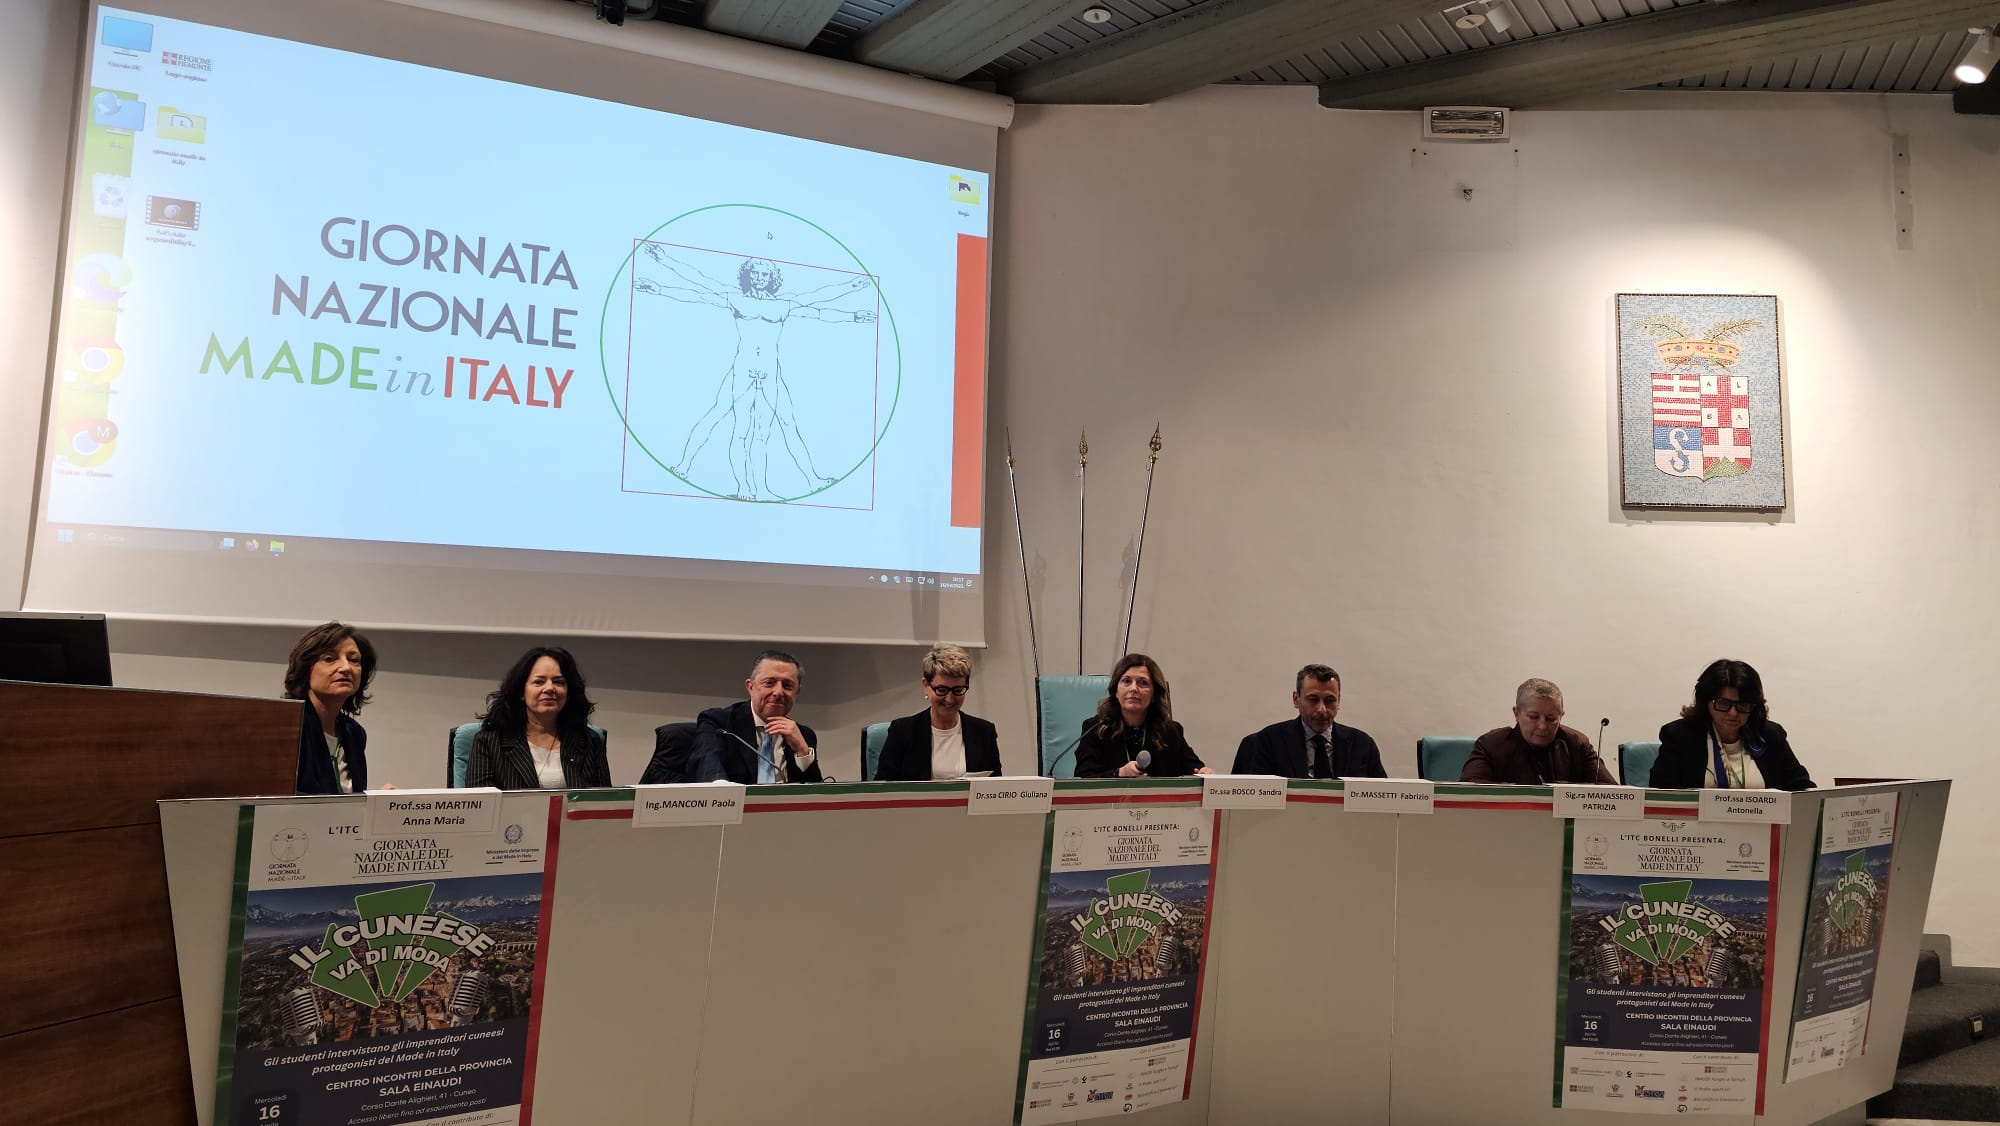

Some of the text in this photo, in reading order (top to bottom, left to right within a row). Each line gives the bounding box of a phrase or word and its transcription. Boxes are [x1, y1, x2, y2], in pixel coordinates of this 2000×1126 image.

[320, 216, 579, 290] GIORNATA
[272, 273, 578, 350] NAZIONALE
[200, 331, 574, 408] MADE in ITALY
[1020, 790, 1048, 798] Giuliana
[1565, 792, 1586, 800] Sig.ra
[388, 800, 482, 811] Prof.ssa MARTINI
[712, 800, 735, 808] Paola
[1727, 807, 1763, 815] Antonella
[402, 816, 465, 826] Anna Maria
[328, 826, 360, 834] L'ITC
[373, 839, 436, 851] GIORNATA
[1117, 837, 1152, 845] GIORNATA
[1108, 845, 1147, 854] NAZIONALE
[1650, 847, 1692, 856] GIORNATA
[354, 848, 453, 864] NAZIONALE DEL
[1109, 854, 1128, 862] MADE
[1138, 852, 1158, 860] ITALY
[1638, 855, 1704, 864] NAZIONALE DEL
[358, 859, 448, 874] MADE IN ITALY
[1640, 862, 1701, 872] MADE IN ITALY
[1825, 870, 1878, 906] IL CUNEESE
[1070, 893, 1183, 932] IL CUNEESE
[1599, 901, 1737, 939] IL CUNEESE
[1092, 915, 1157, 940] VA DI MODA
[1625, 923, 1705, 947] VA DI MODA
[288, 914, 496, 971] IL CUNEESE
[329, 945, 450, 981] VA DI MODA
[1626, 990, 1667, 998] intervistano
[1677, 992, 1719, 1001] imprenditori
[1086, 1002, 1189, 1021] CENTRO INCONTRI DELLA PROVINCIA
[1134, 1016, 1161, 1025] EINAUDI
[1584, 1021, 1598, 1030] 16
[1048, 1029, 1061, 1039] 16
[264, 1028, 504, 1067] Gli studenti intervistano gli imprenditori cuneesi
[312, 1058, 376, 1076] protagonisti
[378, 1056, 394, 1065] del
[396, 1052, 424, 1062] Made
[437, 1047, 460, 1056] Italy
[326, 1057, 512, 1091] CENTRO INCONTRI DELLA PROVINCIA
[379, 1077, 462, 1097] SALA EINAUDI
[454, 1089, 476, 1097] Cuneo
[259, 1105, 280, 1120] 16
